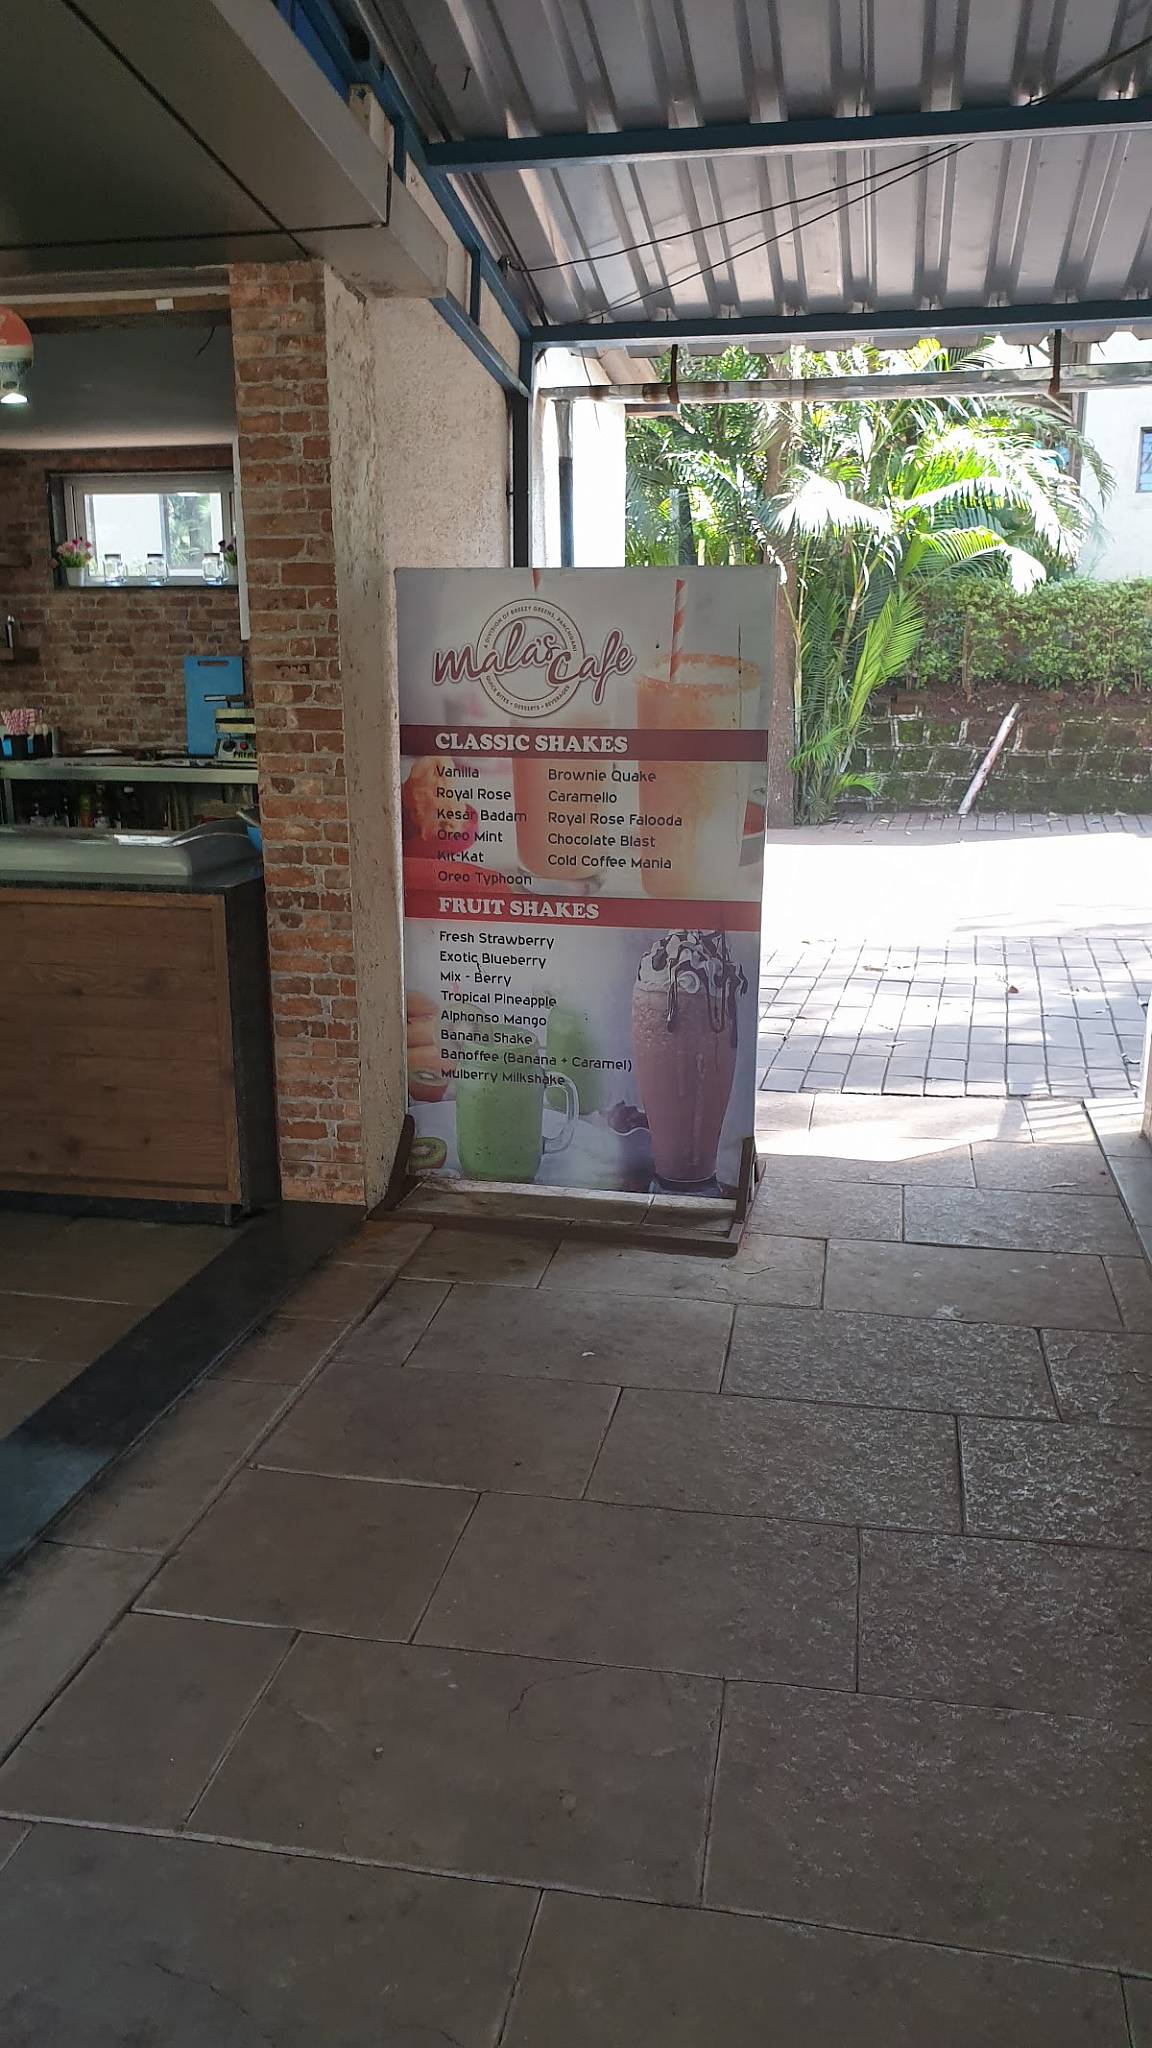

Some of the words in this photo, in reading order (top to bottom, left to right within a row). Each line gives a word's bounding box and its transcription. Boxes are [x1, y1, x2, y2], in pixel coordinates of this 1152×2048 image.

[545, 630, 633, 702] Cafe
[435, 733, 530, 751] CLASSIC
[534, 736, 628, 753] SHAKES
[436, 766, 479, 779] Vanilla
[548, 769, 606, 782] Brownie
[612, 770, 656, 782] Quake
[437, 788, 473, 801] Royal
[477, 789, 512, 800] Rose
[548, 791, 617, 803] Caramello
[437, 809, 477, 821] Kesar
[480, 810, 527, 822] Badam
[548, 812, 586, 826] Royal
[590, 814, 624, 826] Rose
[629, 814, 682, 827] Falooda
[438, 830, 470, 842] Oreo
[474, 831, 503, 843] Mint
[548, 834, 616, 846] Chocolate
[620, 835, 655, 848] Blast
[548, 854, 576, 867] Cold
[581, 855, 626, 868] Coffee
[631, 857, 672, 869] Mania
[438, 871, 470, 883] Oreo
[475, 871, 532, 886] Typhoon
[439, 898, 505, 915] FRUIT
[509, 901, 599, 919] SHAKES
[439, 931, 474, 944] Fresh
[479, 932, 554, 949] Strawberry
[440, 951, 478, 963] Exotic
[482, 953, 546, 968] Blueberry
[440, 971, 461, 982] Mix
[474, 973, 511, 987] Berry
[441, 991, 490, 1005] Tropical
[495, 993, 557, 1008] Pineapple
[441, 1011, 499, 1025] Alphonso
[504, 1013, 547, 1027] Mango
[441, 1030, 490, 1042] Banana
[494, 1032, 533, 1044] Shake
[441, 1049, 499, 1062] Banoffee
[503, 1052, 557, 1066] (Banana
[572, 1056, 632, 1071] Caramel)
[441, 1069, 498, 1083] Mulberry
[502, 1072, 565, 1085] Milkshake
